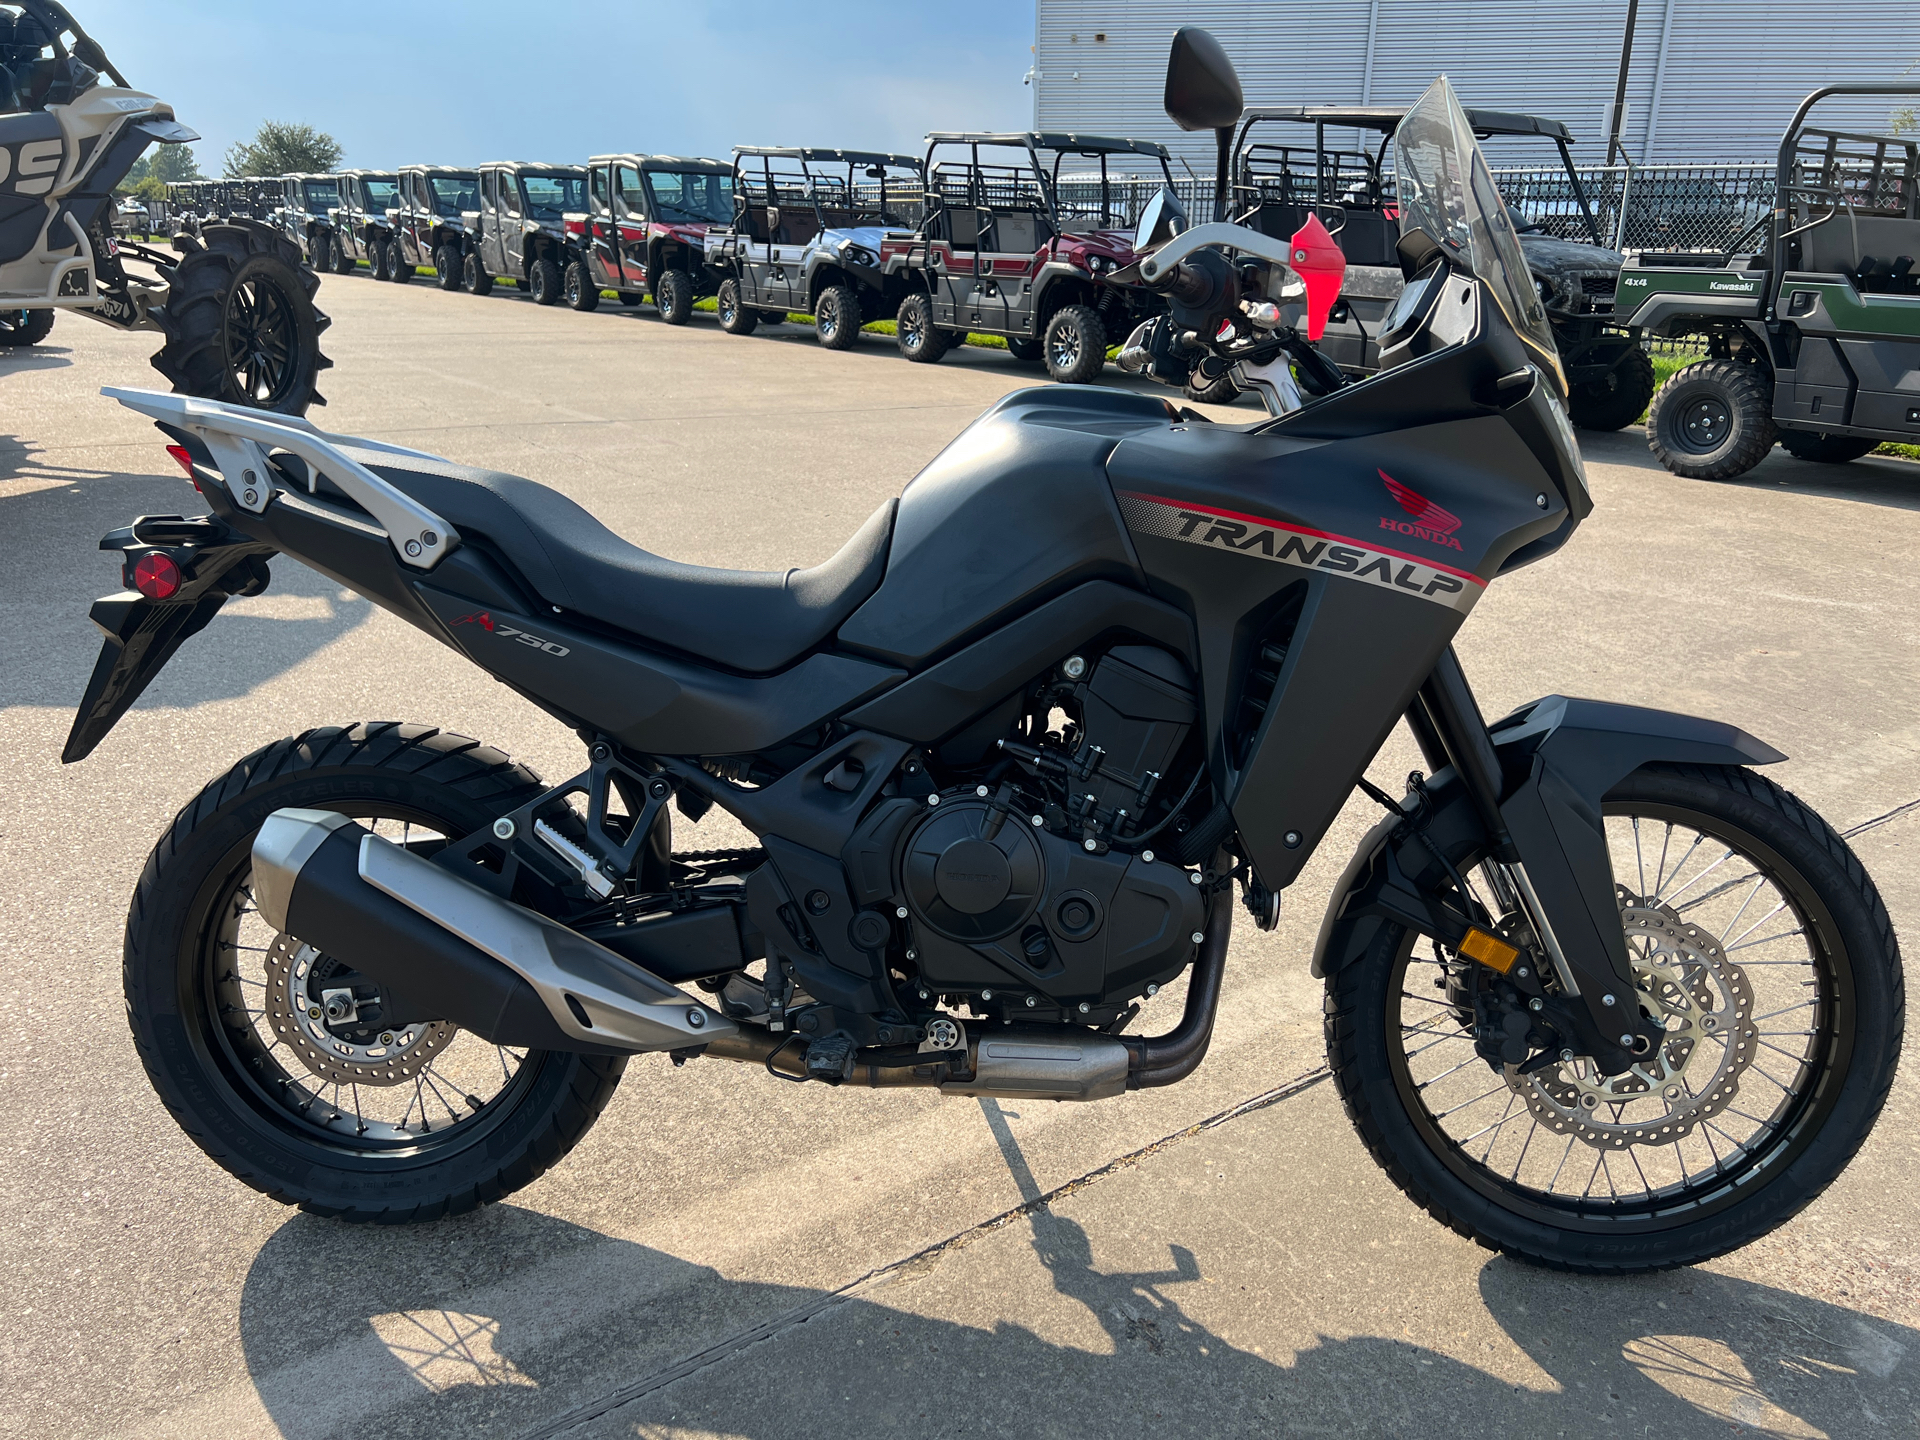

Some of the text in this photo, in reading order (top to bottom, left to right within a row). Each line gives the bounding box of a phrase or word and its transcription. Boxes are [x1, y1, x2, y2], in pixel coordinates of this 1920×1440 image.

[1624, 278, 1648, 287] 4x4
[1710, 281, 1754, 292] Kawasaki
[1378, 516, 1464, 551] HONDA
[1177, 511, 1463, 597] TRANSALP
[495, 624, 571, 657] 750
[250, 780, 377, 820] METZELER
[946, 872, 1000, 883] HONDA
[500, 1080, 552, 1145] STREET
